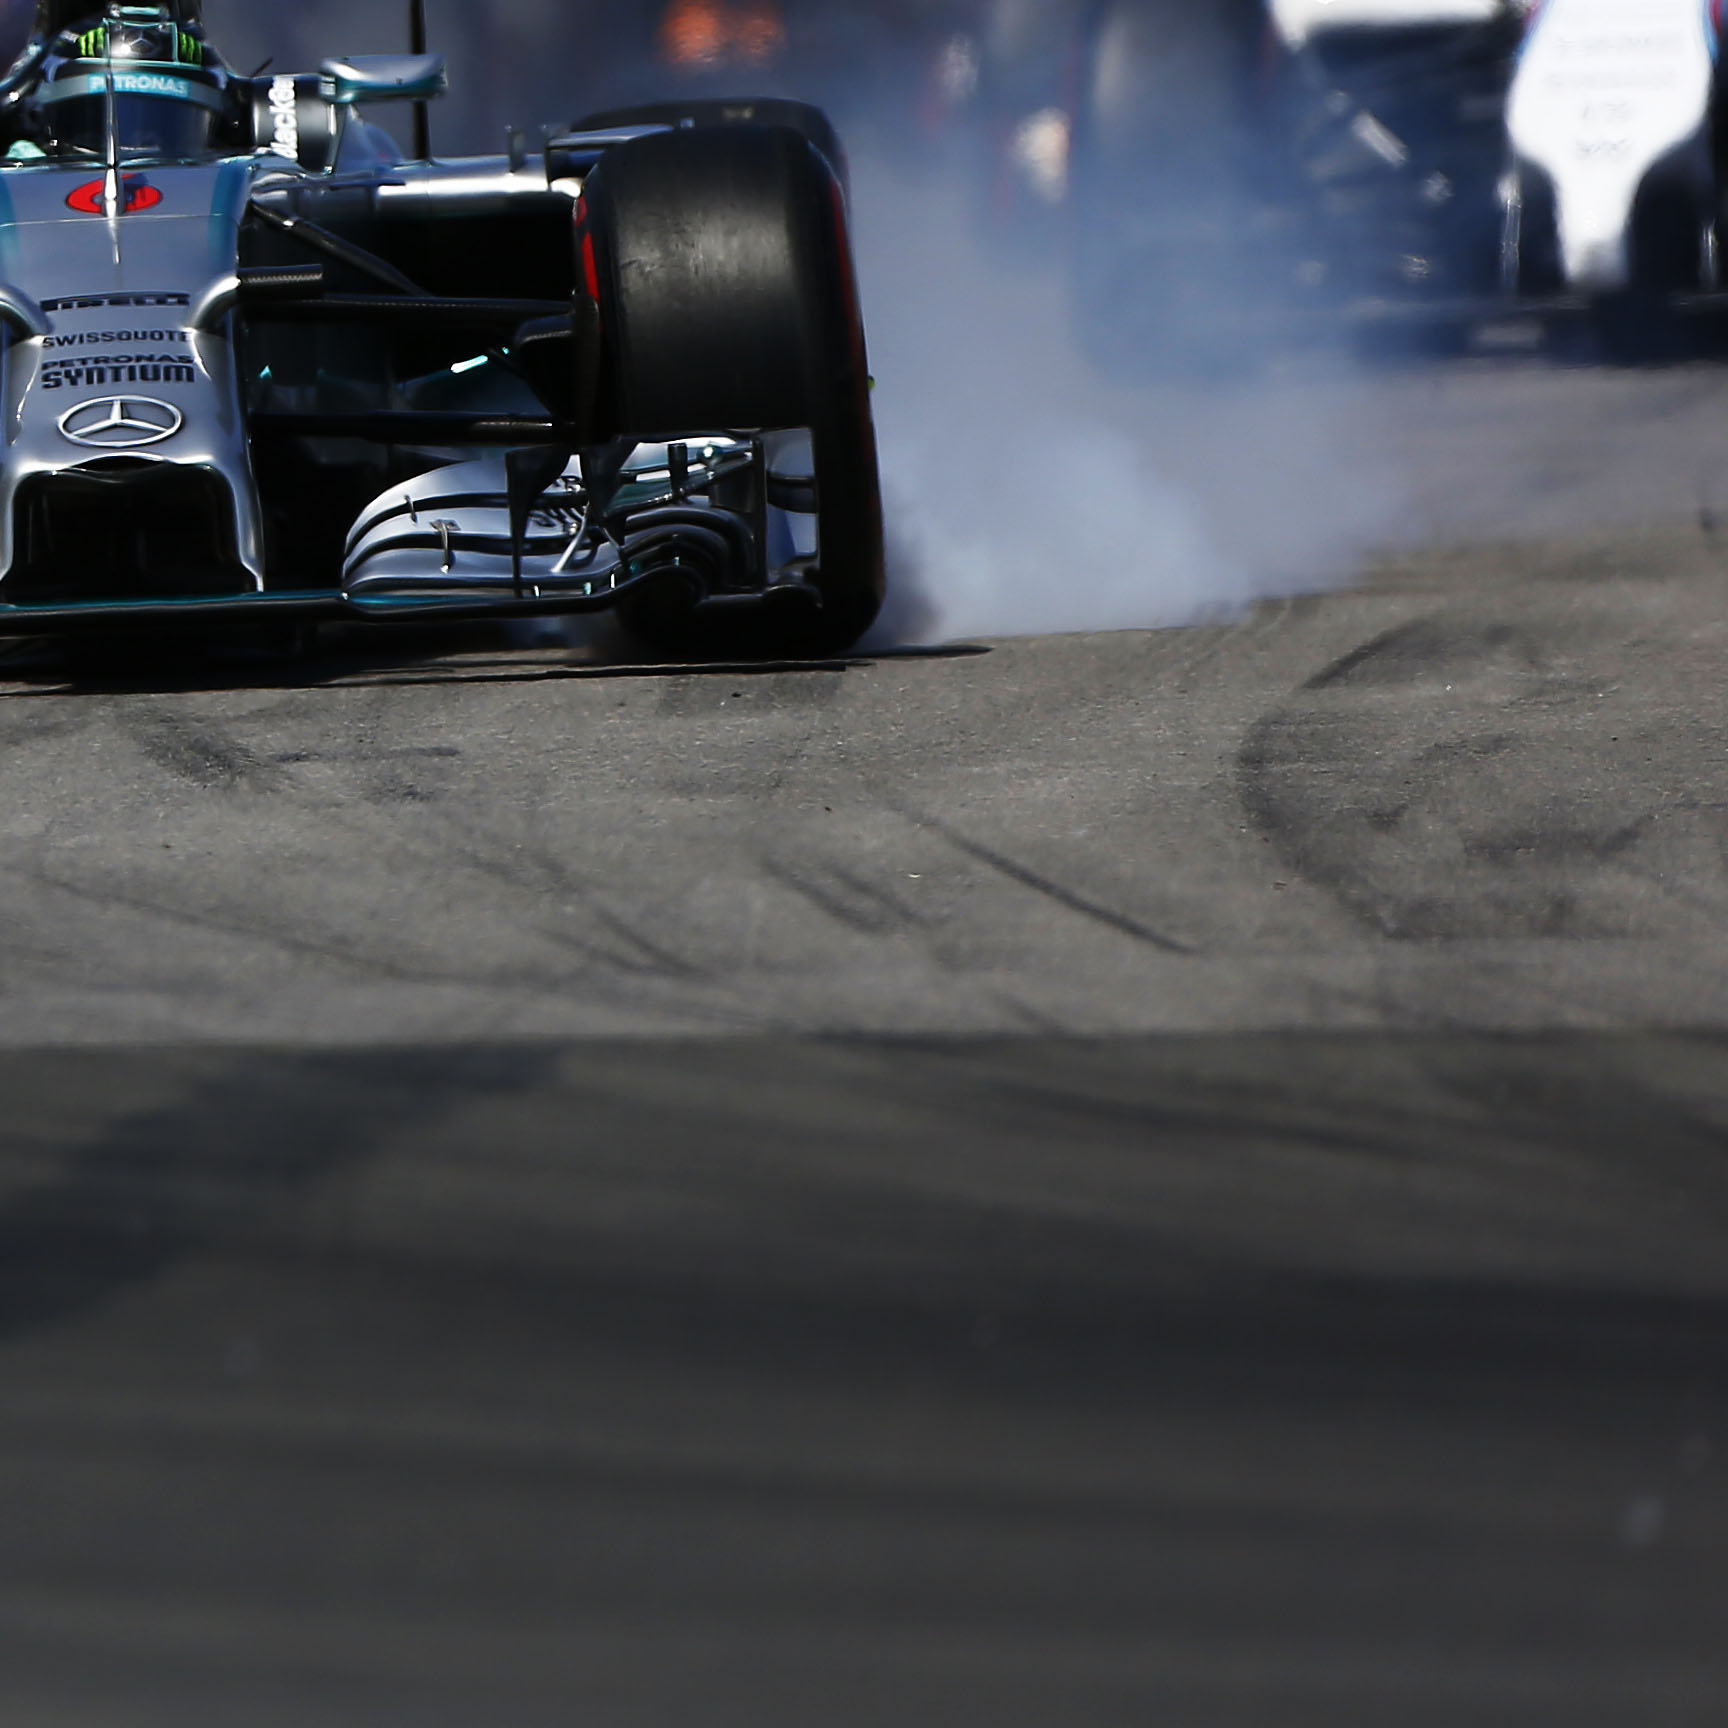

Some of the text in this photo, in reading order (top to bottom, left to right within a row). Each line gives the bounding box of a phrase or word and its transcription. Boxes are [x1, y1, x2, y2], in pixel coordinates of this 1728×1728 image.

[42, 329, 190, 348] SWISSQUOTE
[41, 353, 193, 371] PETRONAS
[41, 364, 195, 390] SYNTIUM
